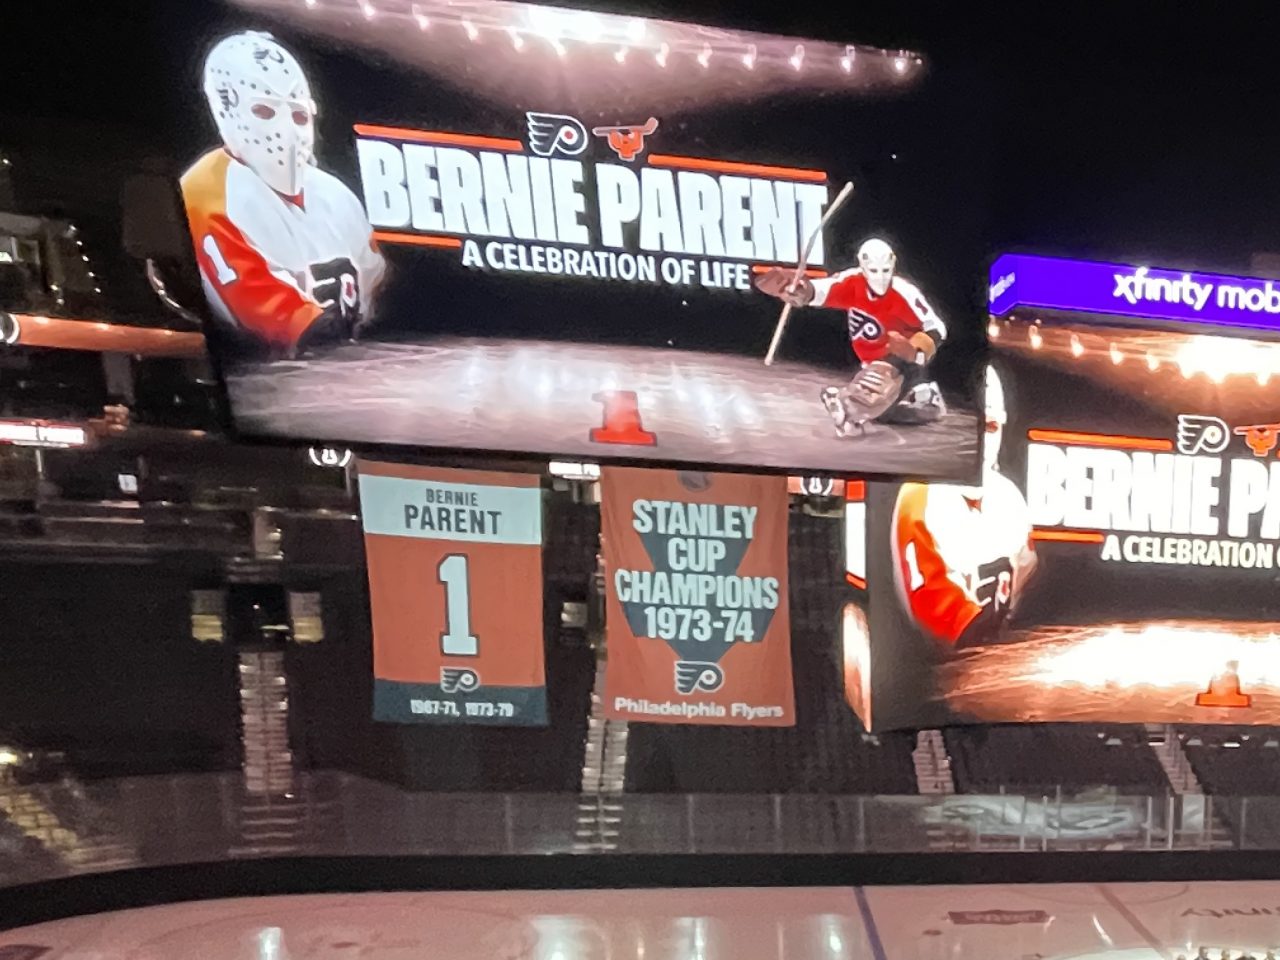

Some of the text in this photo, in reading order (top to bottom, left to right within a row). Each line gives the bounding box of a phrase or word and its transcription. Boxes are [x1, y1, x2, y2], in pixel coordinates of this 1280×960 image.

[356, 138, 829, 266] BERNIE PARENT
[462, 239, 751, 290] A CELEBRATION OF LIFE
[1112, 266, 1213, 311] xfinity
[425, 488, 478, 507] BERNIE
[1026, 443, 1222, 536] BERNIE
[404, 504, 502, 535] PARENT
[632, 499, 758, 539] STANLEY
[667, 537, 727, 573] CUP
[1101, 534, 1122, 561] A
[1123, 535, 1274, 569] CELEBRATION
[437, 553, 481, 657] 1
[614, 568, 780, 610] CHAMPIONS
[644, 606, 755, 643] 1973-74
[614, 697, 784, 720] Philadelphia Flyers
